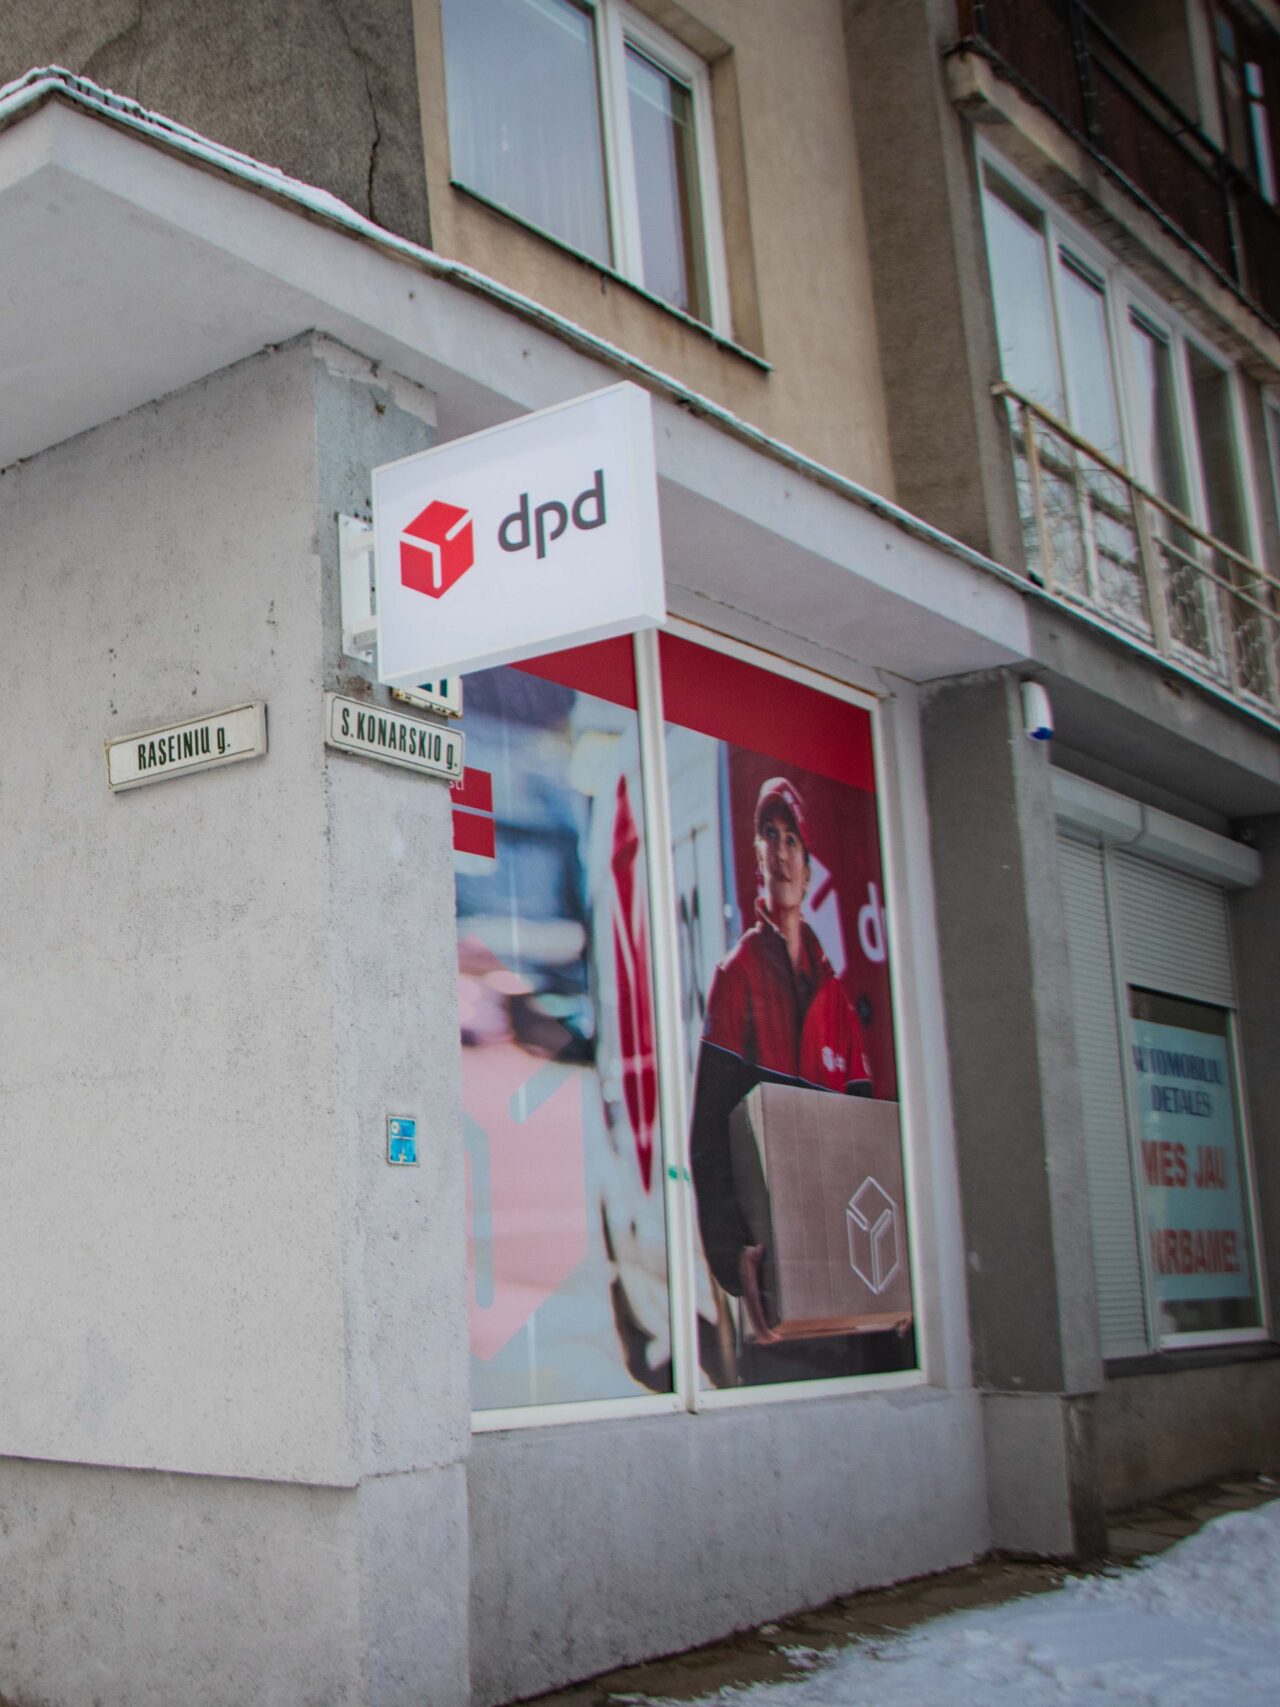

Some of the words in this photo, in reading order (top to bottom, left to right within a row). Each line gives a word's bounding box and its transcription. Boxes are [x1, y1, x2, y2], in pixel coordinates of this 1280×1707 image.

[498, 468, 607, 560] dpd
[137, 726, 211, 771] RASEINIŲ
[217, 726, 231, 754] g.
[1141, 1140, 1188, 1188] MES
